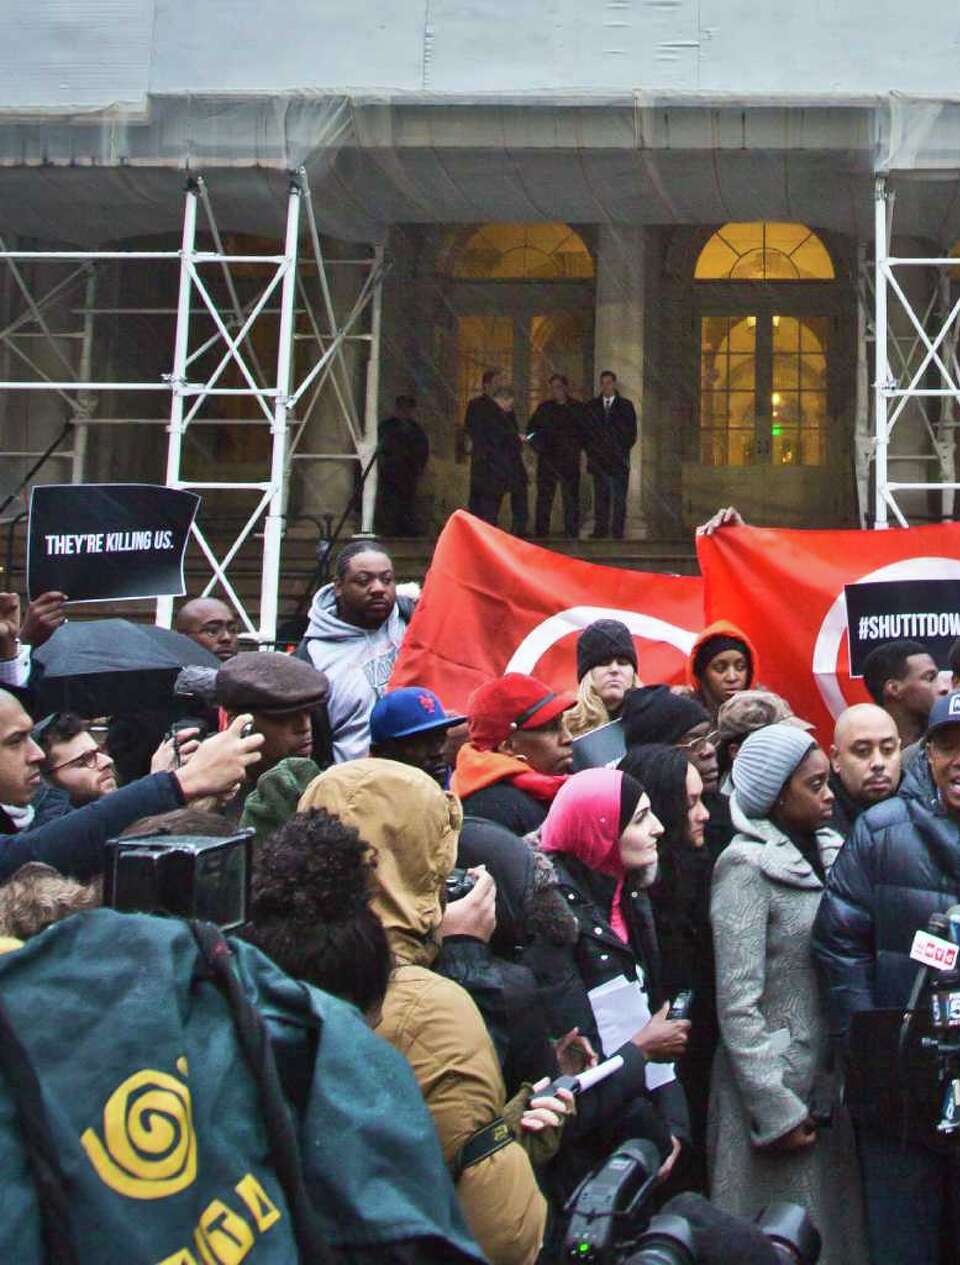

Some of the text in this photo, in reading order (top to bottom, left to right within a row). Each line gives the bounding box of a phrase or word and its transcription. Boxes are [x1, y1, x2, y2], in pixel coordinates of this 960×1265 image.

[45, 530, 175, 555] THEY'RE KILLING US.
